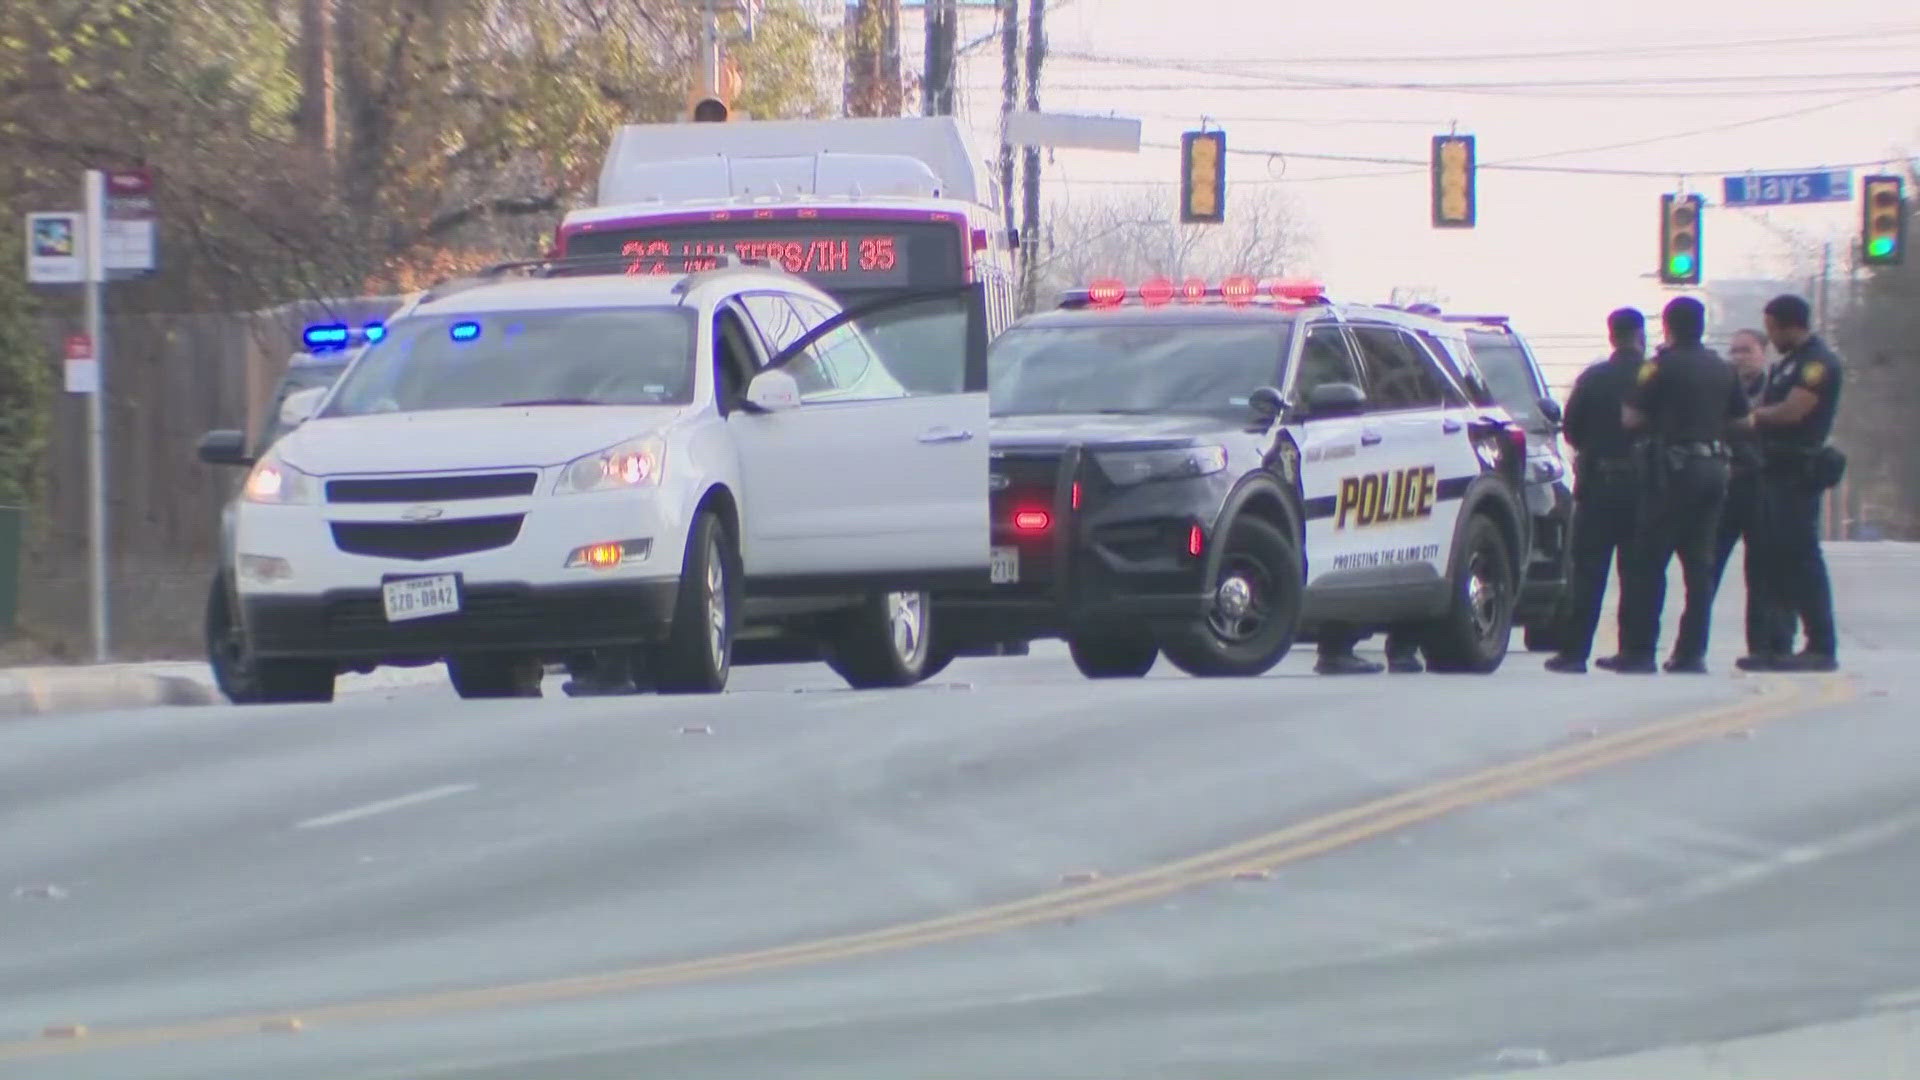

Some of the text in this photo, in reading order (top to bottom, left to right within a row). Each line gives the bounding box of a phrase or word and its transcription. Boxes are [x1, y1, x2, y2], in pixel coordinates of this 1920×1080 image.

[1745, 175, 1810, 204] Hays
[622, 240, 670, 275] 22
[859, 236, 895, 271] 35
[1336, 465, 1435, 530] POLICE
[1333, 551, 1379, 570] PROTECTING
[1381, 548, 1395, 564] THE
[1422, 543, 1439, 559] CITY
